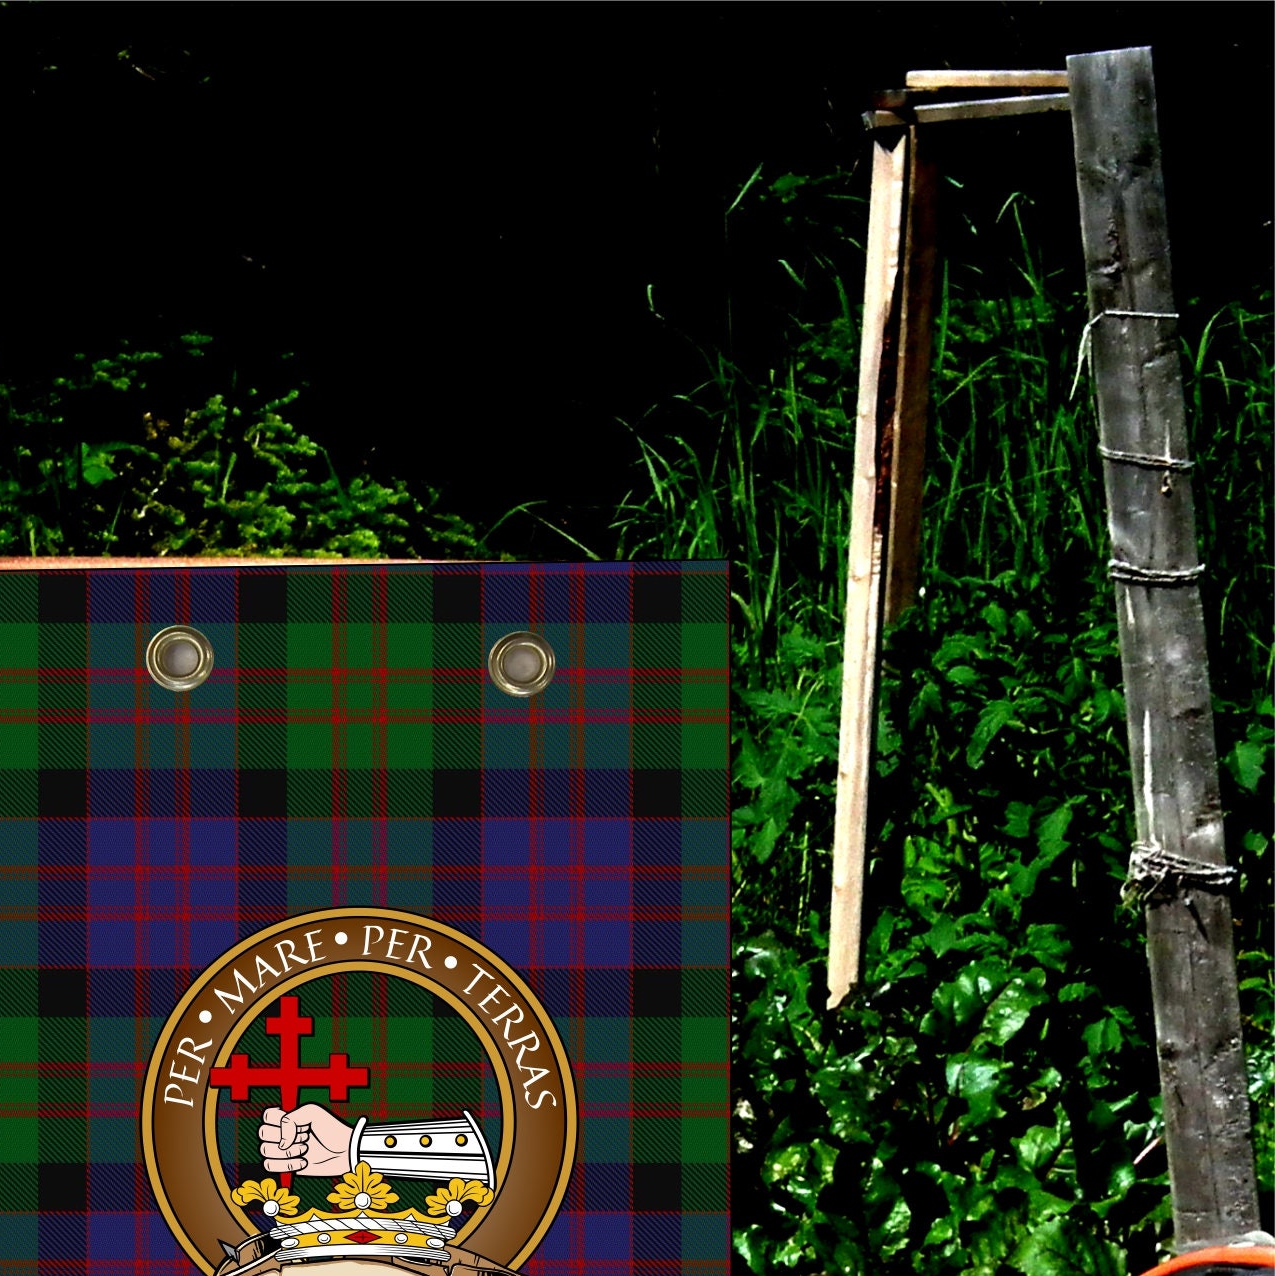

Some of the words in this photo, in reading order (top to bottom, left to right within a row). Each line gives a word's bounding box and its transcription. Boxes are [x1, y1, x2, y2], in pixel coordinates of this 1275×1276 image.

[163, 1035, 214, 1109] PER
[213, 928, 327, 1016] MARE
[361, 924, 434, 970] PER
[461, 962, 558, 1111] TERRAS
